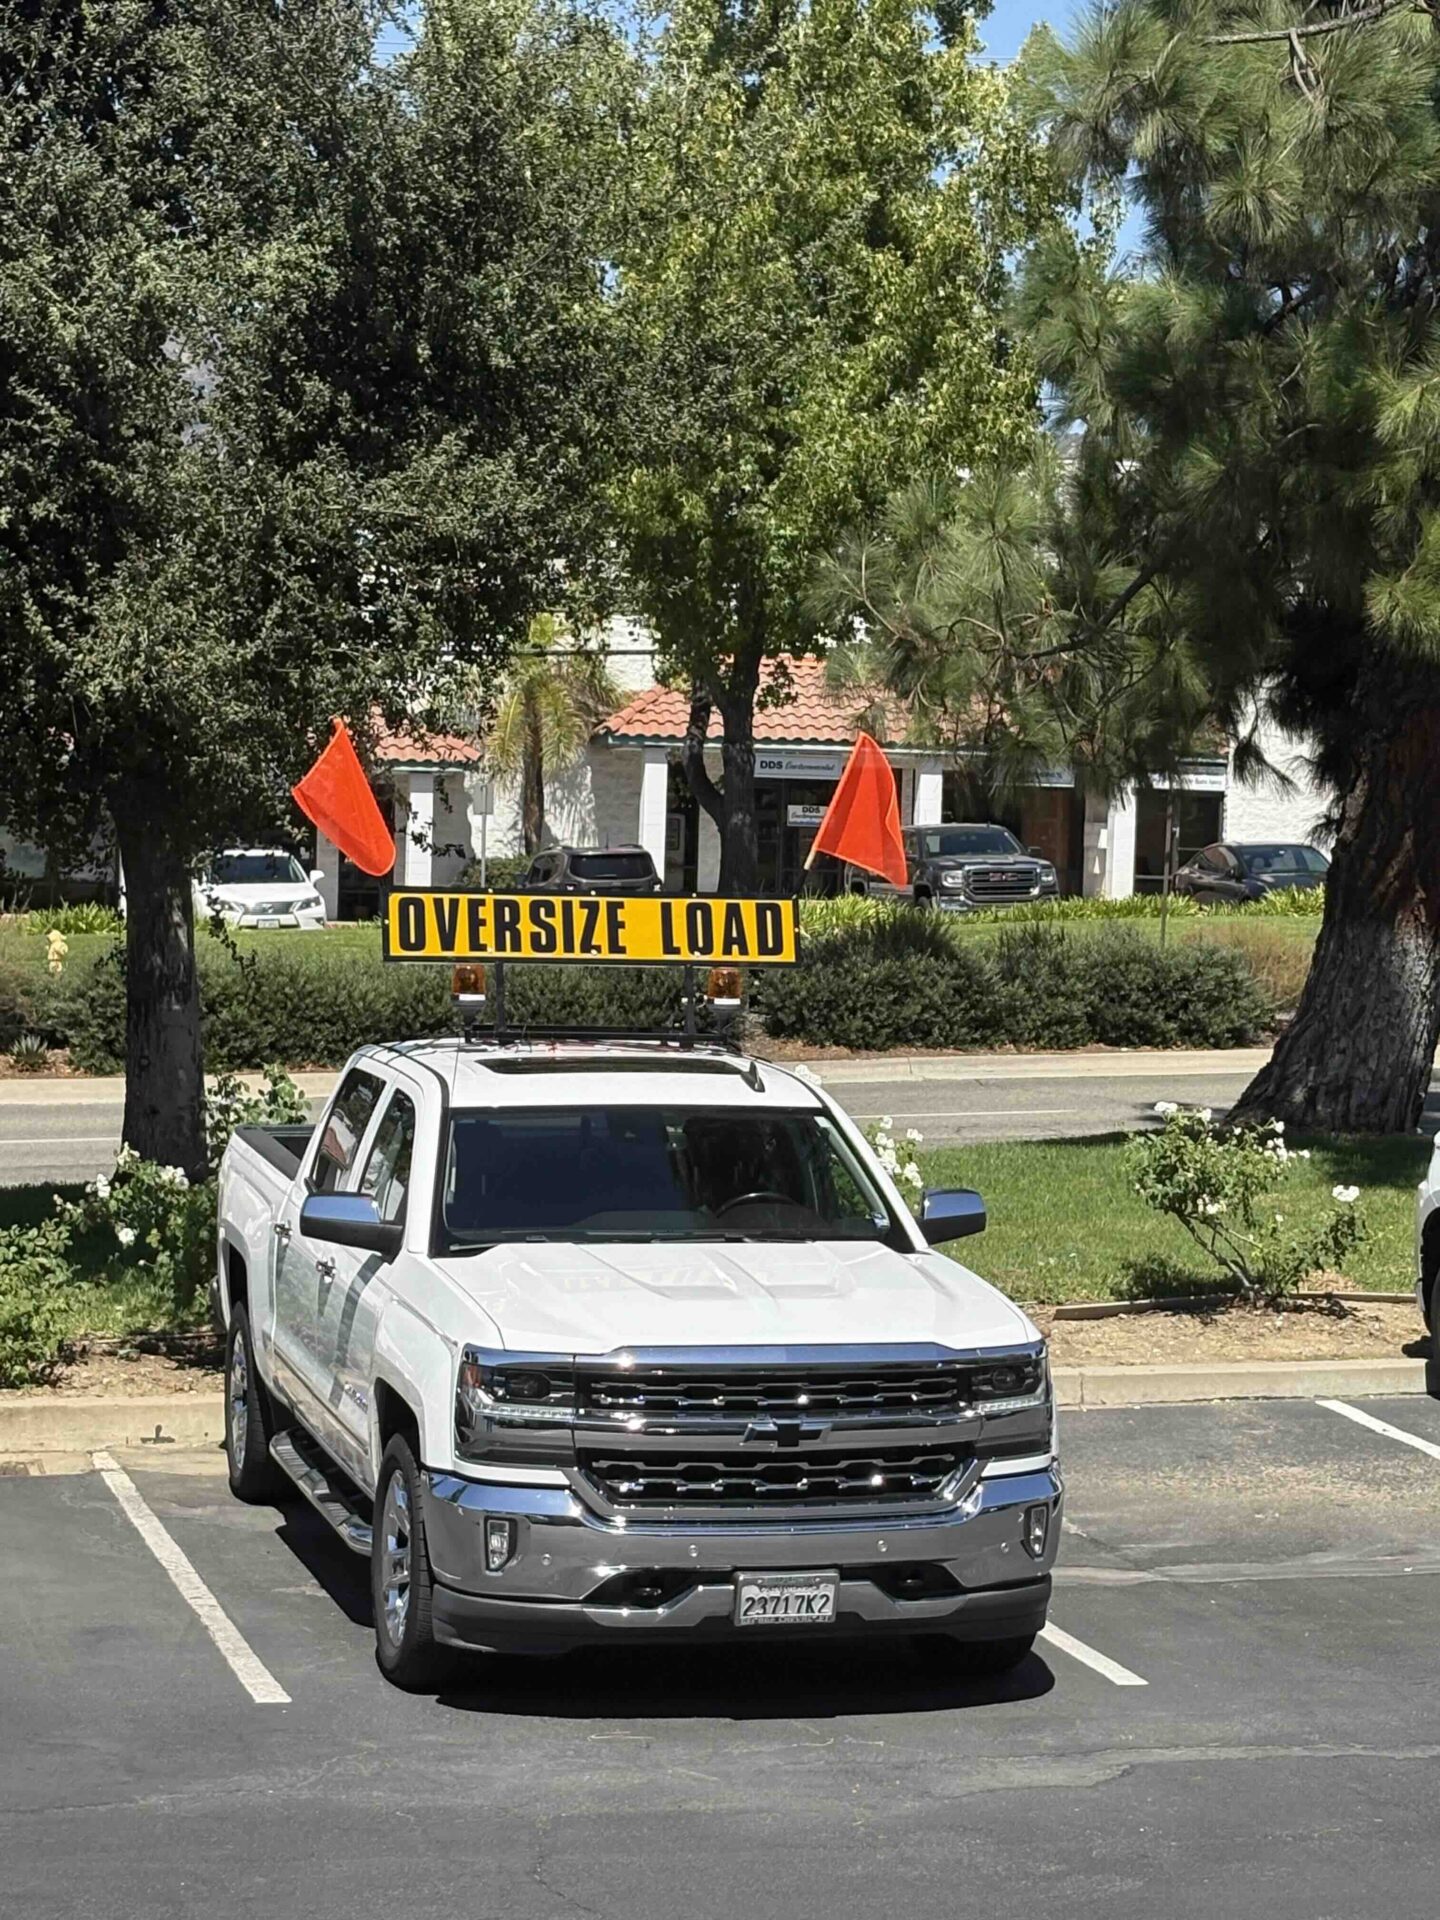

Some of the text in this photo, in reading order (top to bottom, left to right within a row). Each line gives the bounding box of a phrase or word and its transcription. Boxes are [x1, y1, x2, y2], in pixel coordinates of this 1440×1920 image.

[760, 760, 783, 770] DDS
[802, 806, 821, 814] DDS
[398, 896, 784, 957] OVERSIZE LOAD
[743, 1594, 830, 1617] 23717K2
